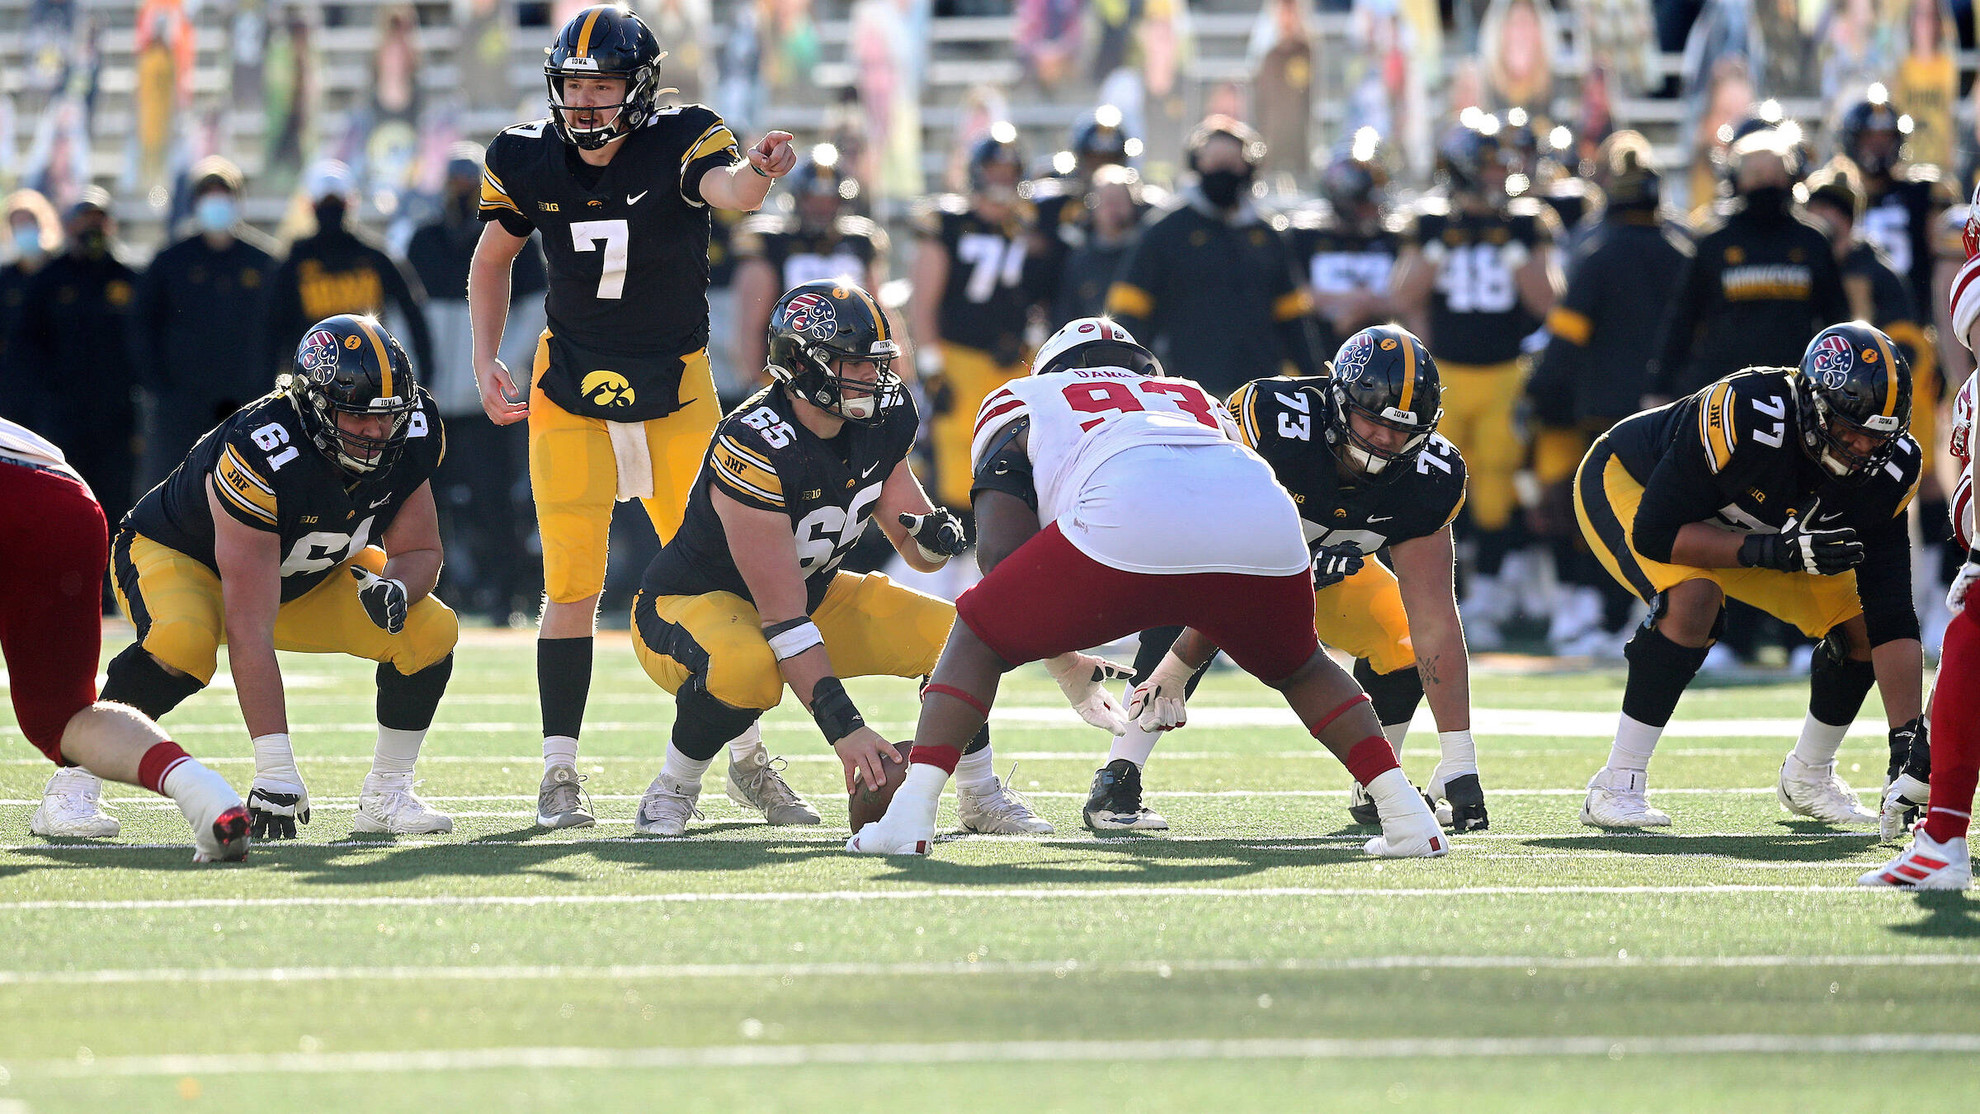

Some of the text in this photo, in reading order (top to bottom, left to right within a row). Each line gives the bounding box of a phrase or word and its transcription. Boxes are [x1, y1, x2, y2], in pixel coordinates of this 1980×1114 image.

[570, 219, 629, 300] 7
[380, 399, 396, 407] IOWA
[1061, 380, 1219, 434] 93
[1273, 391, 1311, 441] 73
[1393, 410, 1410, 420] IOWA
[1709, 403, 1721, 429] JHF
[1751, 395, 1786, 449] 77
[1878, 417, 1893, 425] IOWA
[250, 422, 300, 473] 61
[740, 406, 798, 450] 65
[227, 468, 250, 492] JHF
[724, 455, 748, 475] JHF
[795, 480, 884, 580] 65
